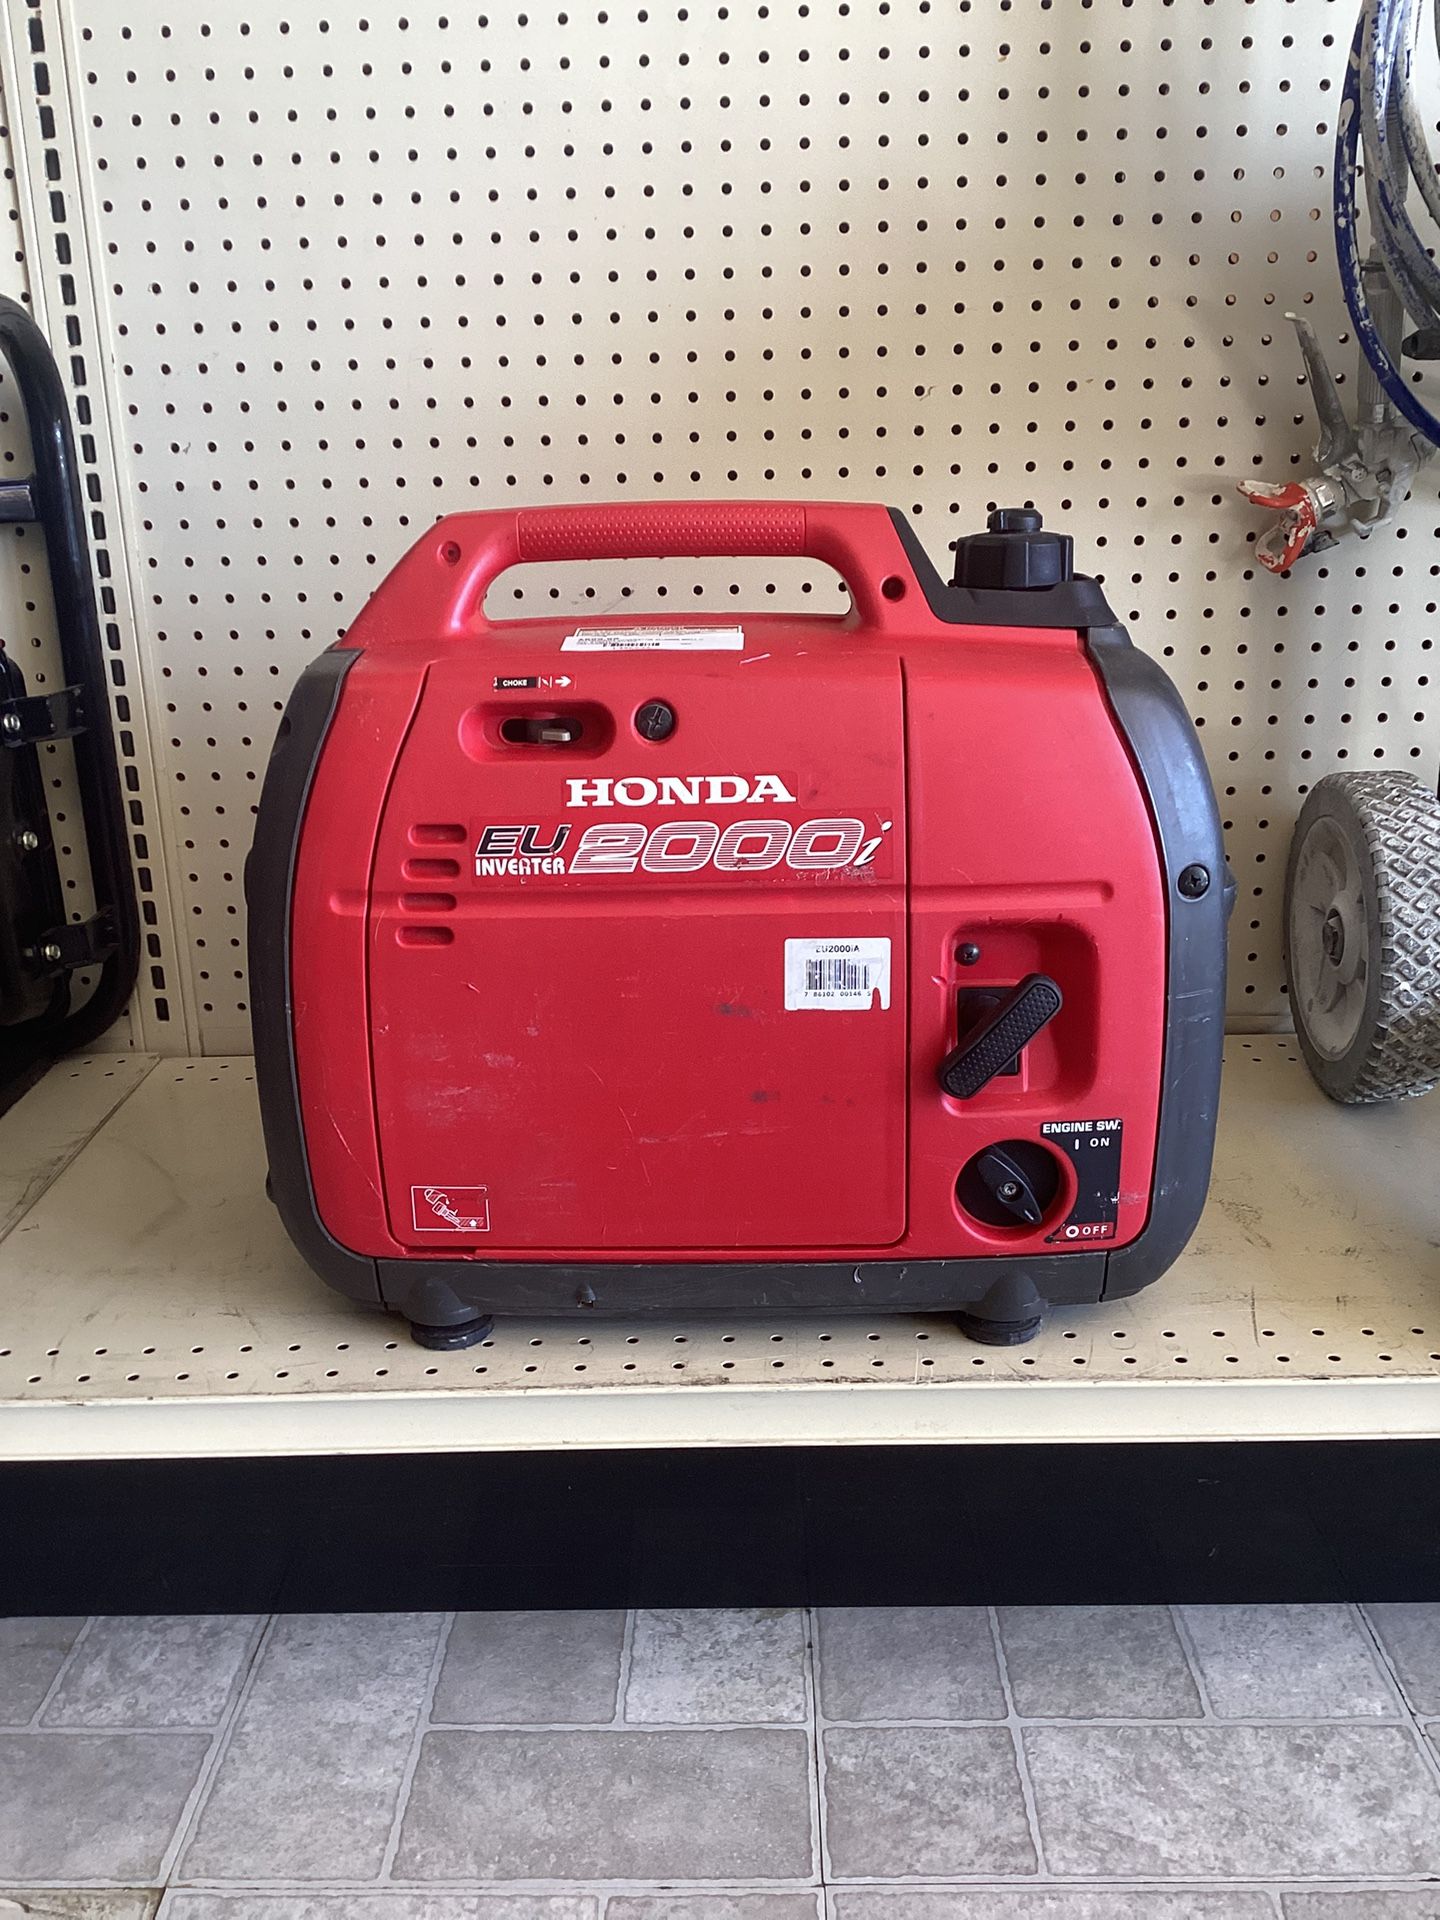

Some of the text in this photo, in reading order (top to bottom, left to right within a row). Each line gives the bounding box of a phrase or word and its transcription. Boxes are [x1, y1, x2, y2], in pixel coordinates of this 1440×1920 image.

[502, 679, 528, 687] CHOKE
[566, 775, 797, 807] HONDA
[475, 818, 893, 874] EU 2000i
[475, 857, 566, 876] INVERTER
[1042, 1119, 1121, 1134] ENGINE SW.
[1089, 1137, 1110, 1147] ON
[1082, 1225, 1108, 1235] OFF
